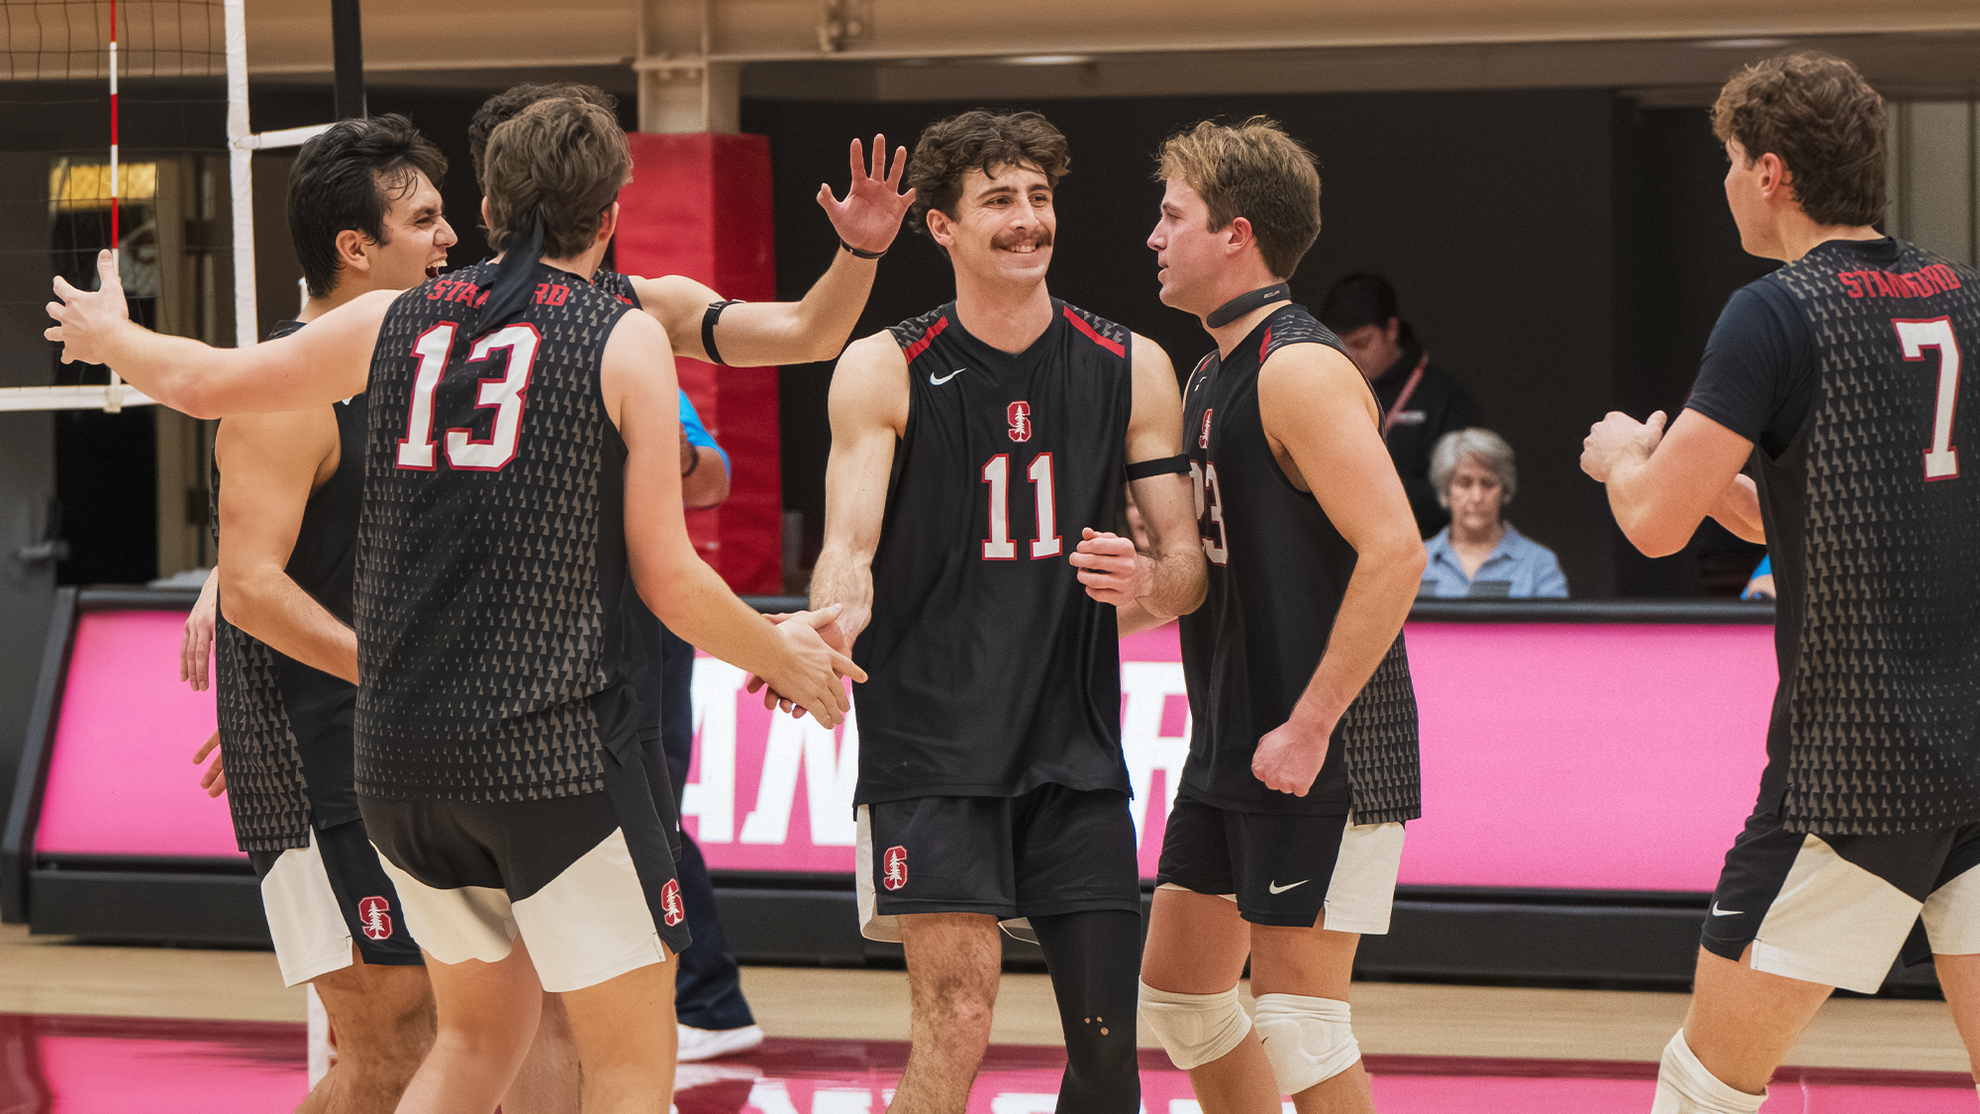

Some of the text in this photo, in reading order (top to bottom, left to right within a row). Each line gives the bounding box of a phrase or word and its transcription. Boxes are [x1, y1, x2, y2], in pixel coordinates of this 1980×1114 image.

[427, 279, 571, 309] STARD
[1837, 264, 1962, 299] STANFORD
[396, 320, 542, 472] 13
[1890, 315, 1962, 482] 7
[981, 452, 1063, 561] 11
